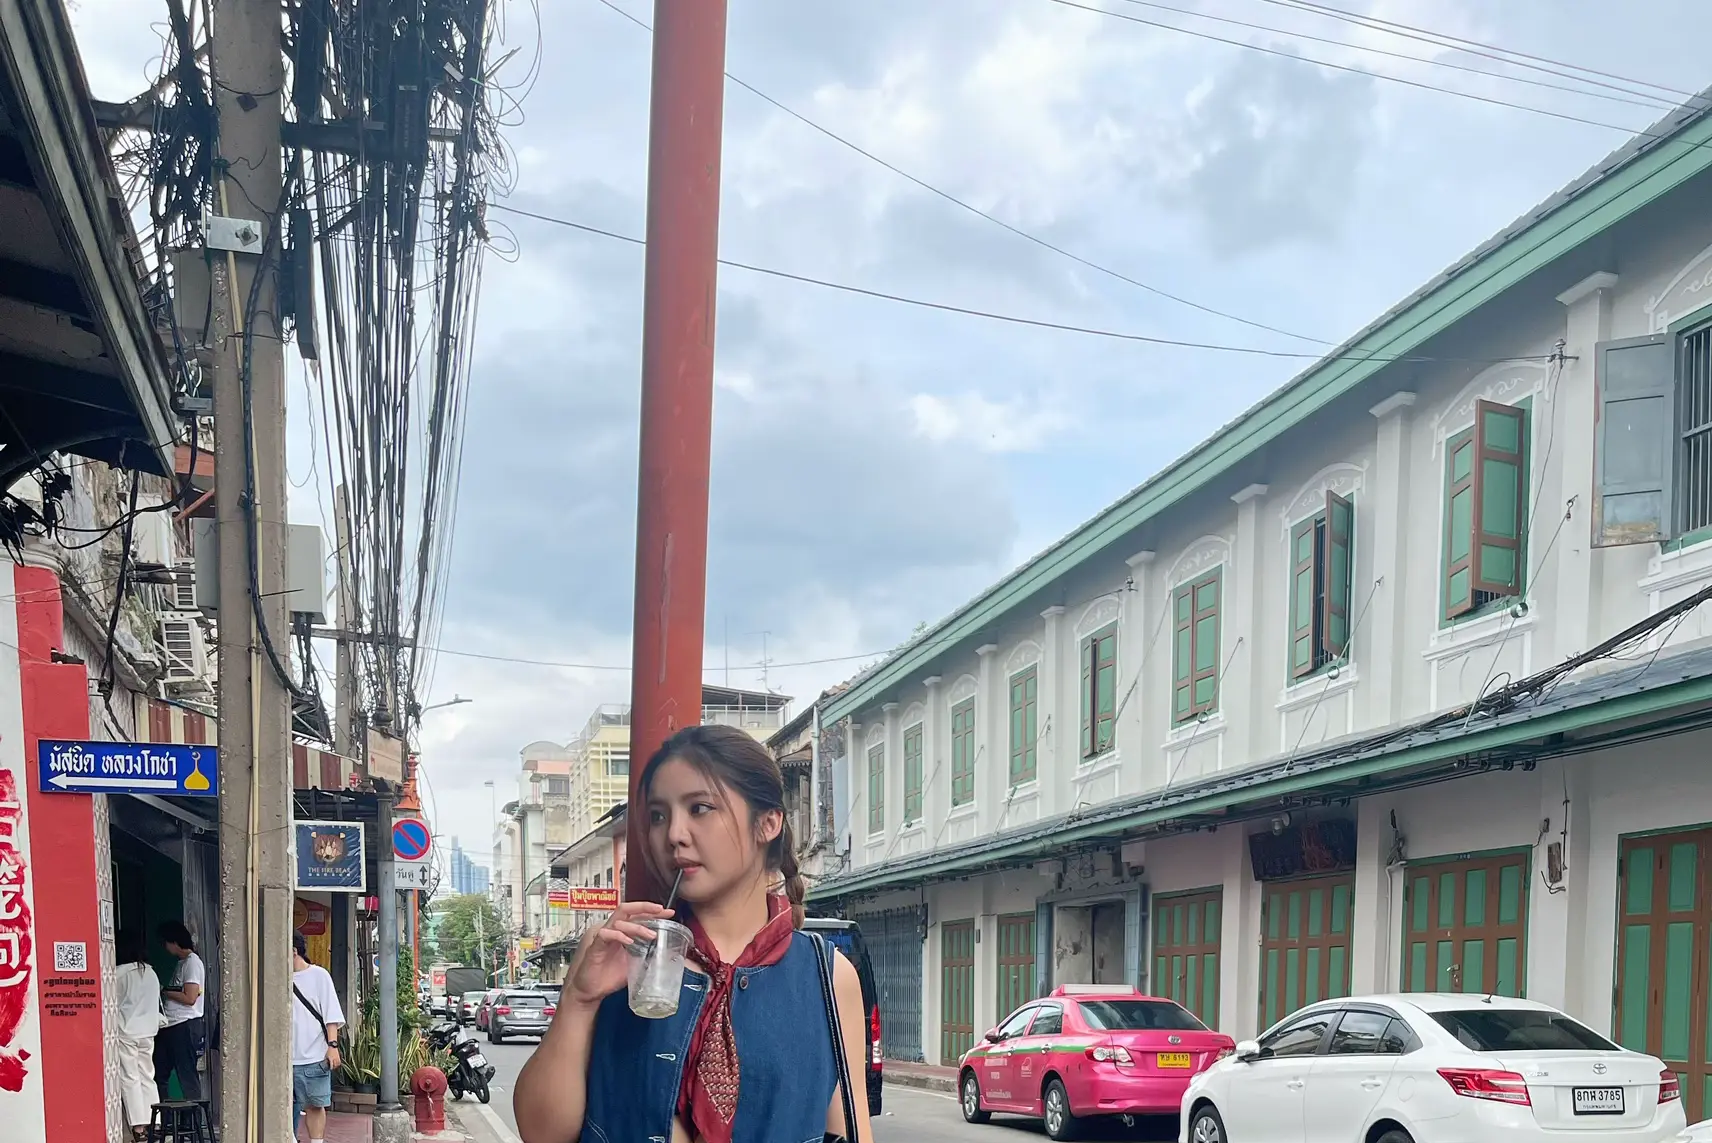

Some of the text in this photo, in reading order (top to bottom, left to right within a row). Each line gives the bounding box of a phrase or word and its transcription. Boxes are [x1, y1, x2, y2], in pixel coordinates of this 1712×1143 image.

[49, 745, 177, 776] มัสยิด หลวงโกชา
[395, 868, 414, 882] วันคู่
[1598, 1090, 1621, 1101] 3785
